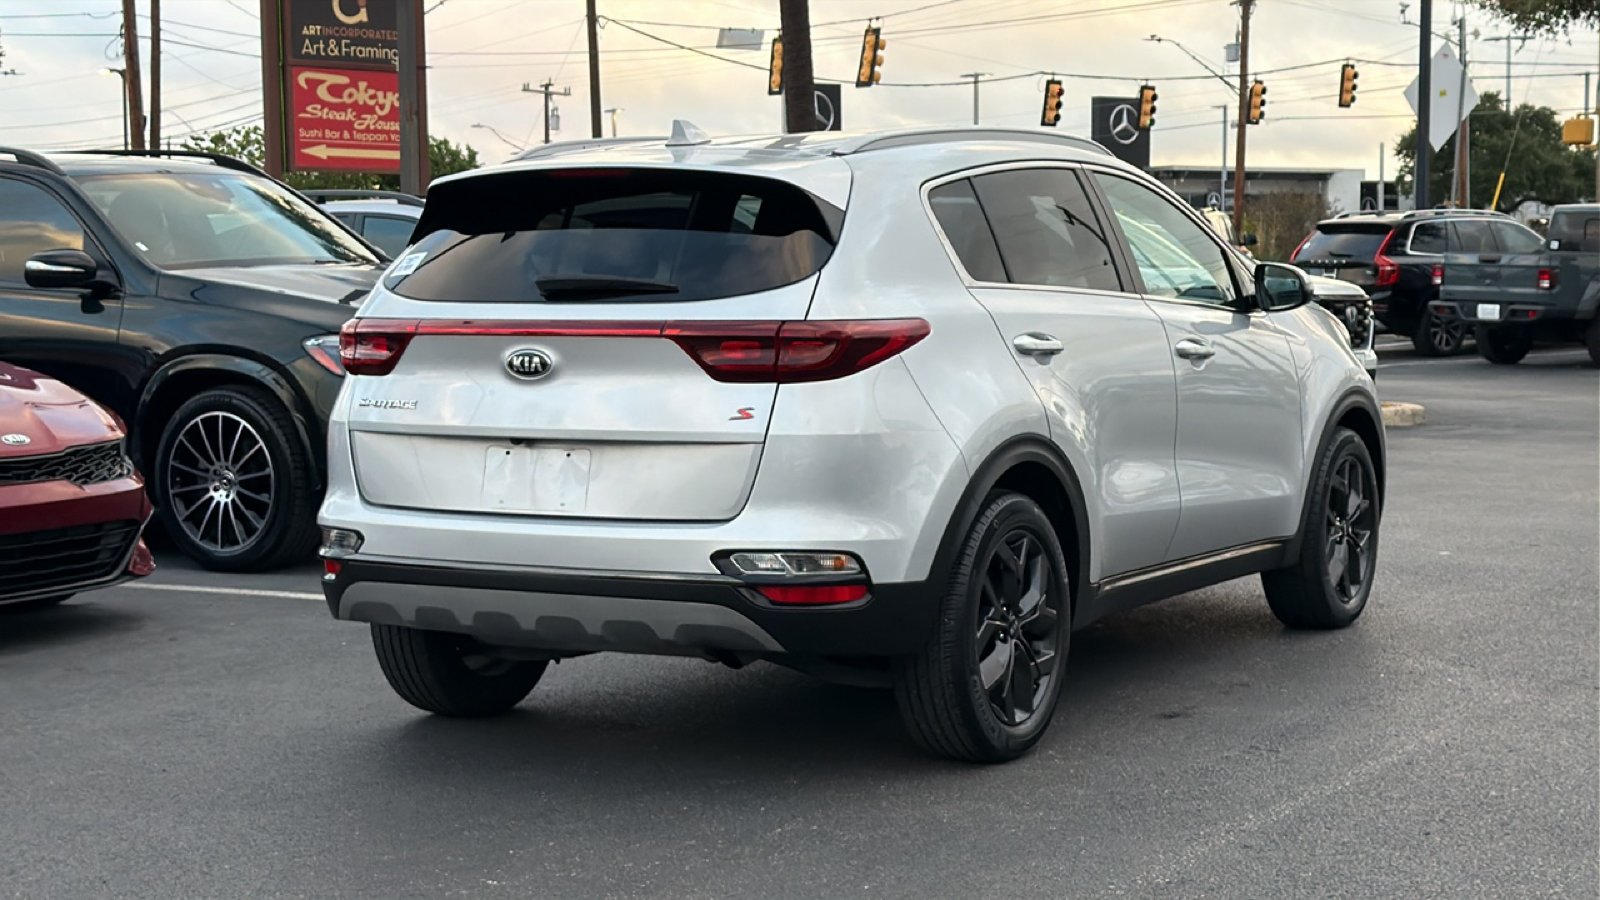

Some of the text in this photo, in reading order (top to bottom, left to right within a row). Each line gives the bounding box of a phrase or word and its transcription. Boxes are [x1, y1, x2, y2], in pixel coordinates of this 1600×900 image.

[302, 39, 399, 65] Art & Framing
[298, 104, 357, 121] Steak
[299, 127, 323, 138] Sushi
[324, 128, 341, 139] Bar
[343, 130, 351, 139] &
[353, 130, 388, 143] Teppan
[513, 355, 543, 372] KIA
